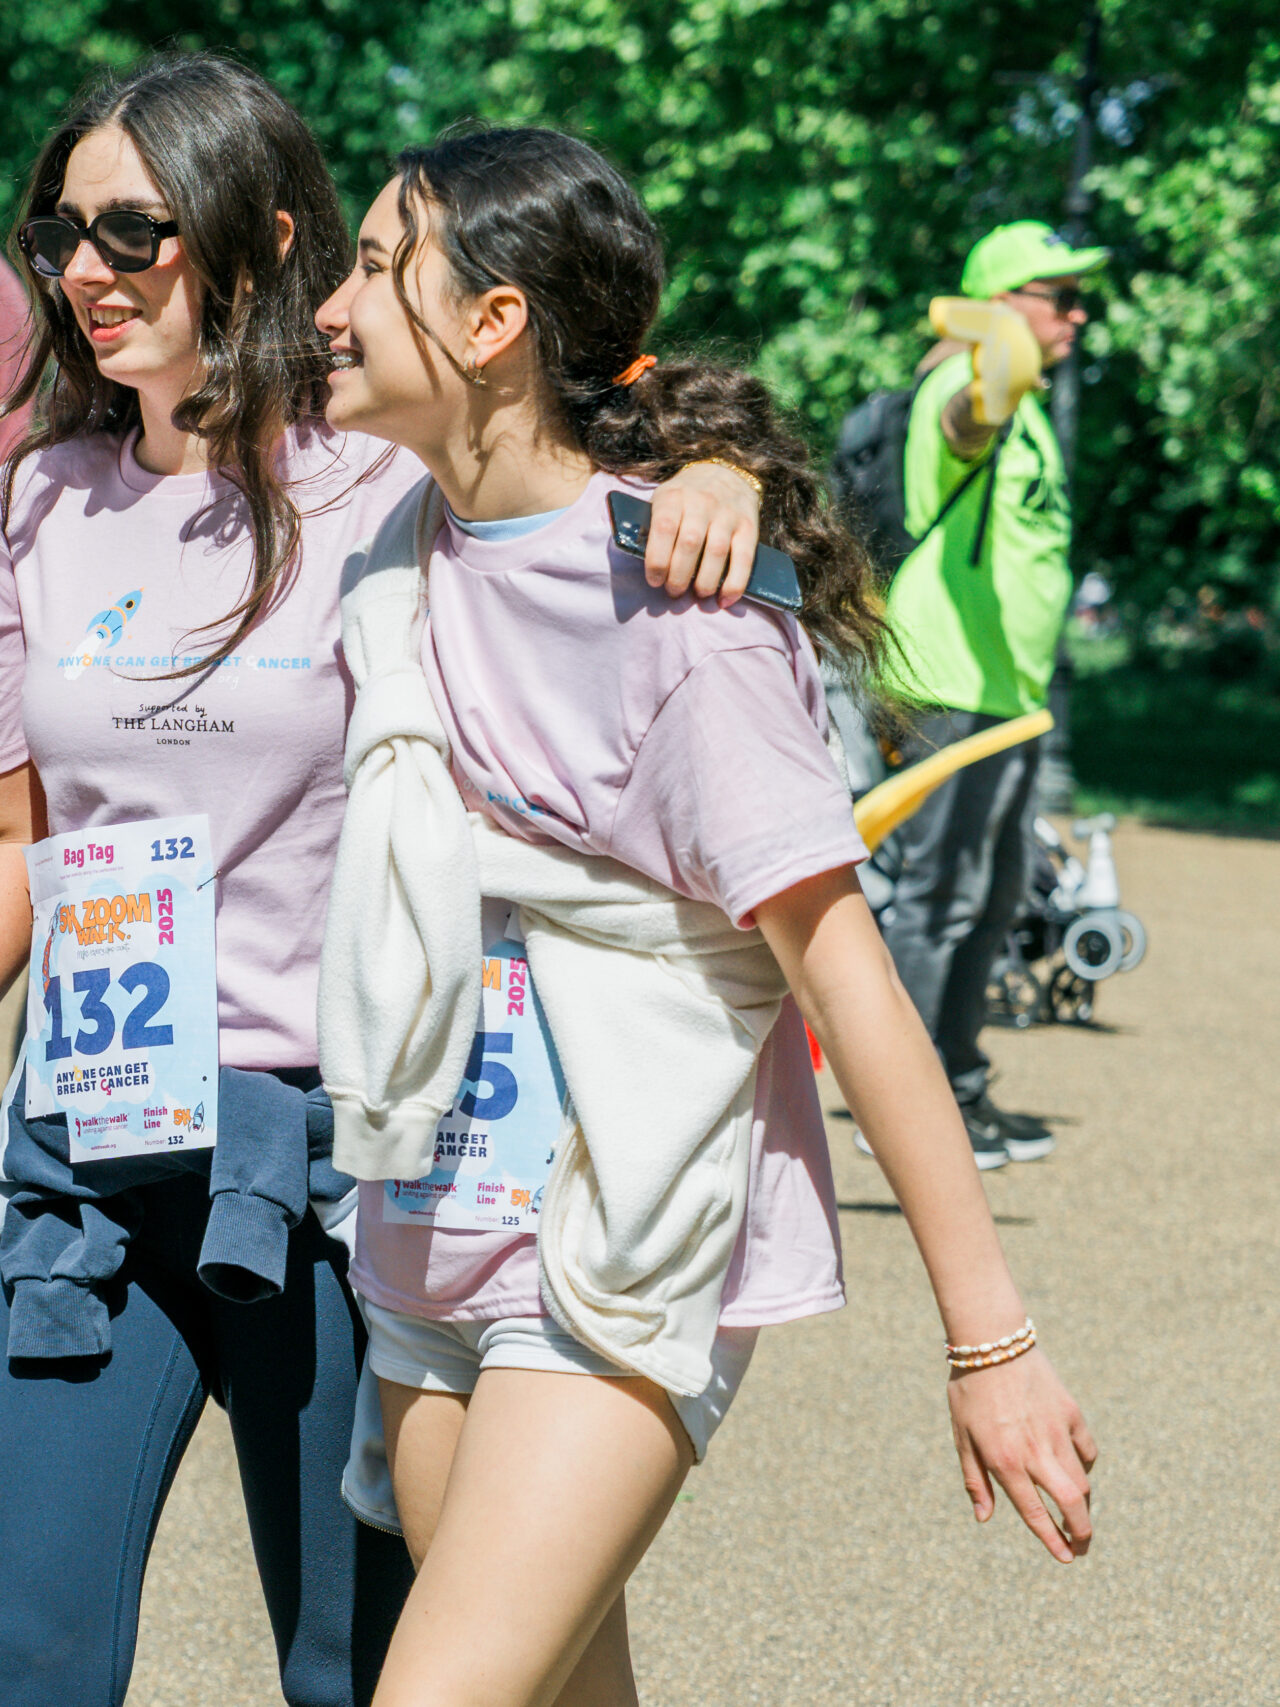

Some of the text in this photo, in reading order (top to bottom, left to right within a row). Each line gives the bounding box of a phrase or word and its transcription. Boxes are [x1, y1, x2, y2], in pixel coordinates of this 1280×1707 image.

[57, 653, 111, 668] ANYONE
[115, 656, 145, 667] CAN
[150, 656, 178, 667] GET
[246, 655, 311, 671] CANCER
[139, 703, 207, 718] Supported by
[112, 717, 235, 733] THE LANGHAM
[156, 738, 190, 746] LONDON
[63, 848, 85, 868] Bag
[87, 843, 114, 864] Tag
[150, 836, 195, 862] 132
[59, 893, 152, 934] 5K ZOOM
[156, 888, 174, 945] 2025
[507, 957, 527, 1016] 2025
[43, 961, 174, 1062] 132
[56, 1062, 148, 1084] ANYONE CAN GET
[57, 1074, 149, 1096] BREAST CANCER
[143, 1106, 168, 1117] Finish
[173, 1108, 191, 1126] 5K
[143, 1120, 161, 1129] Line
[168, 1135, 184, 1145] 132
[436, 1131, 488, 1145] AN GET
[477, 1182, 505, 1193] Finish
[477, 1195, 496, 1205] Line
[510, 1189, 531, 1208] 5K
[501, 1216, 520, 1226] 125
